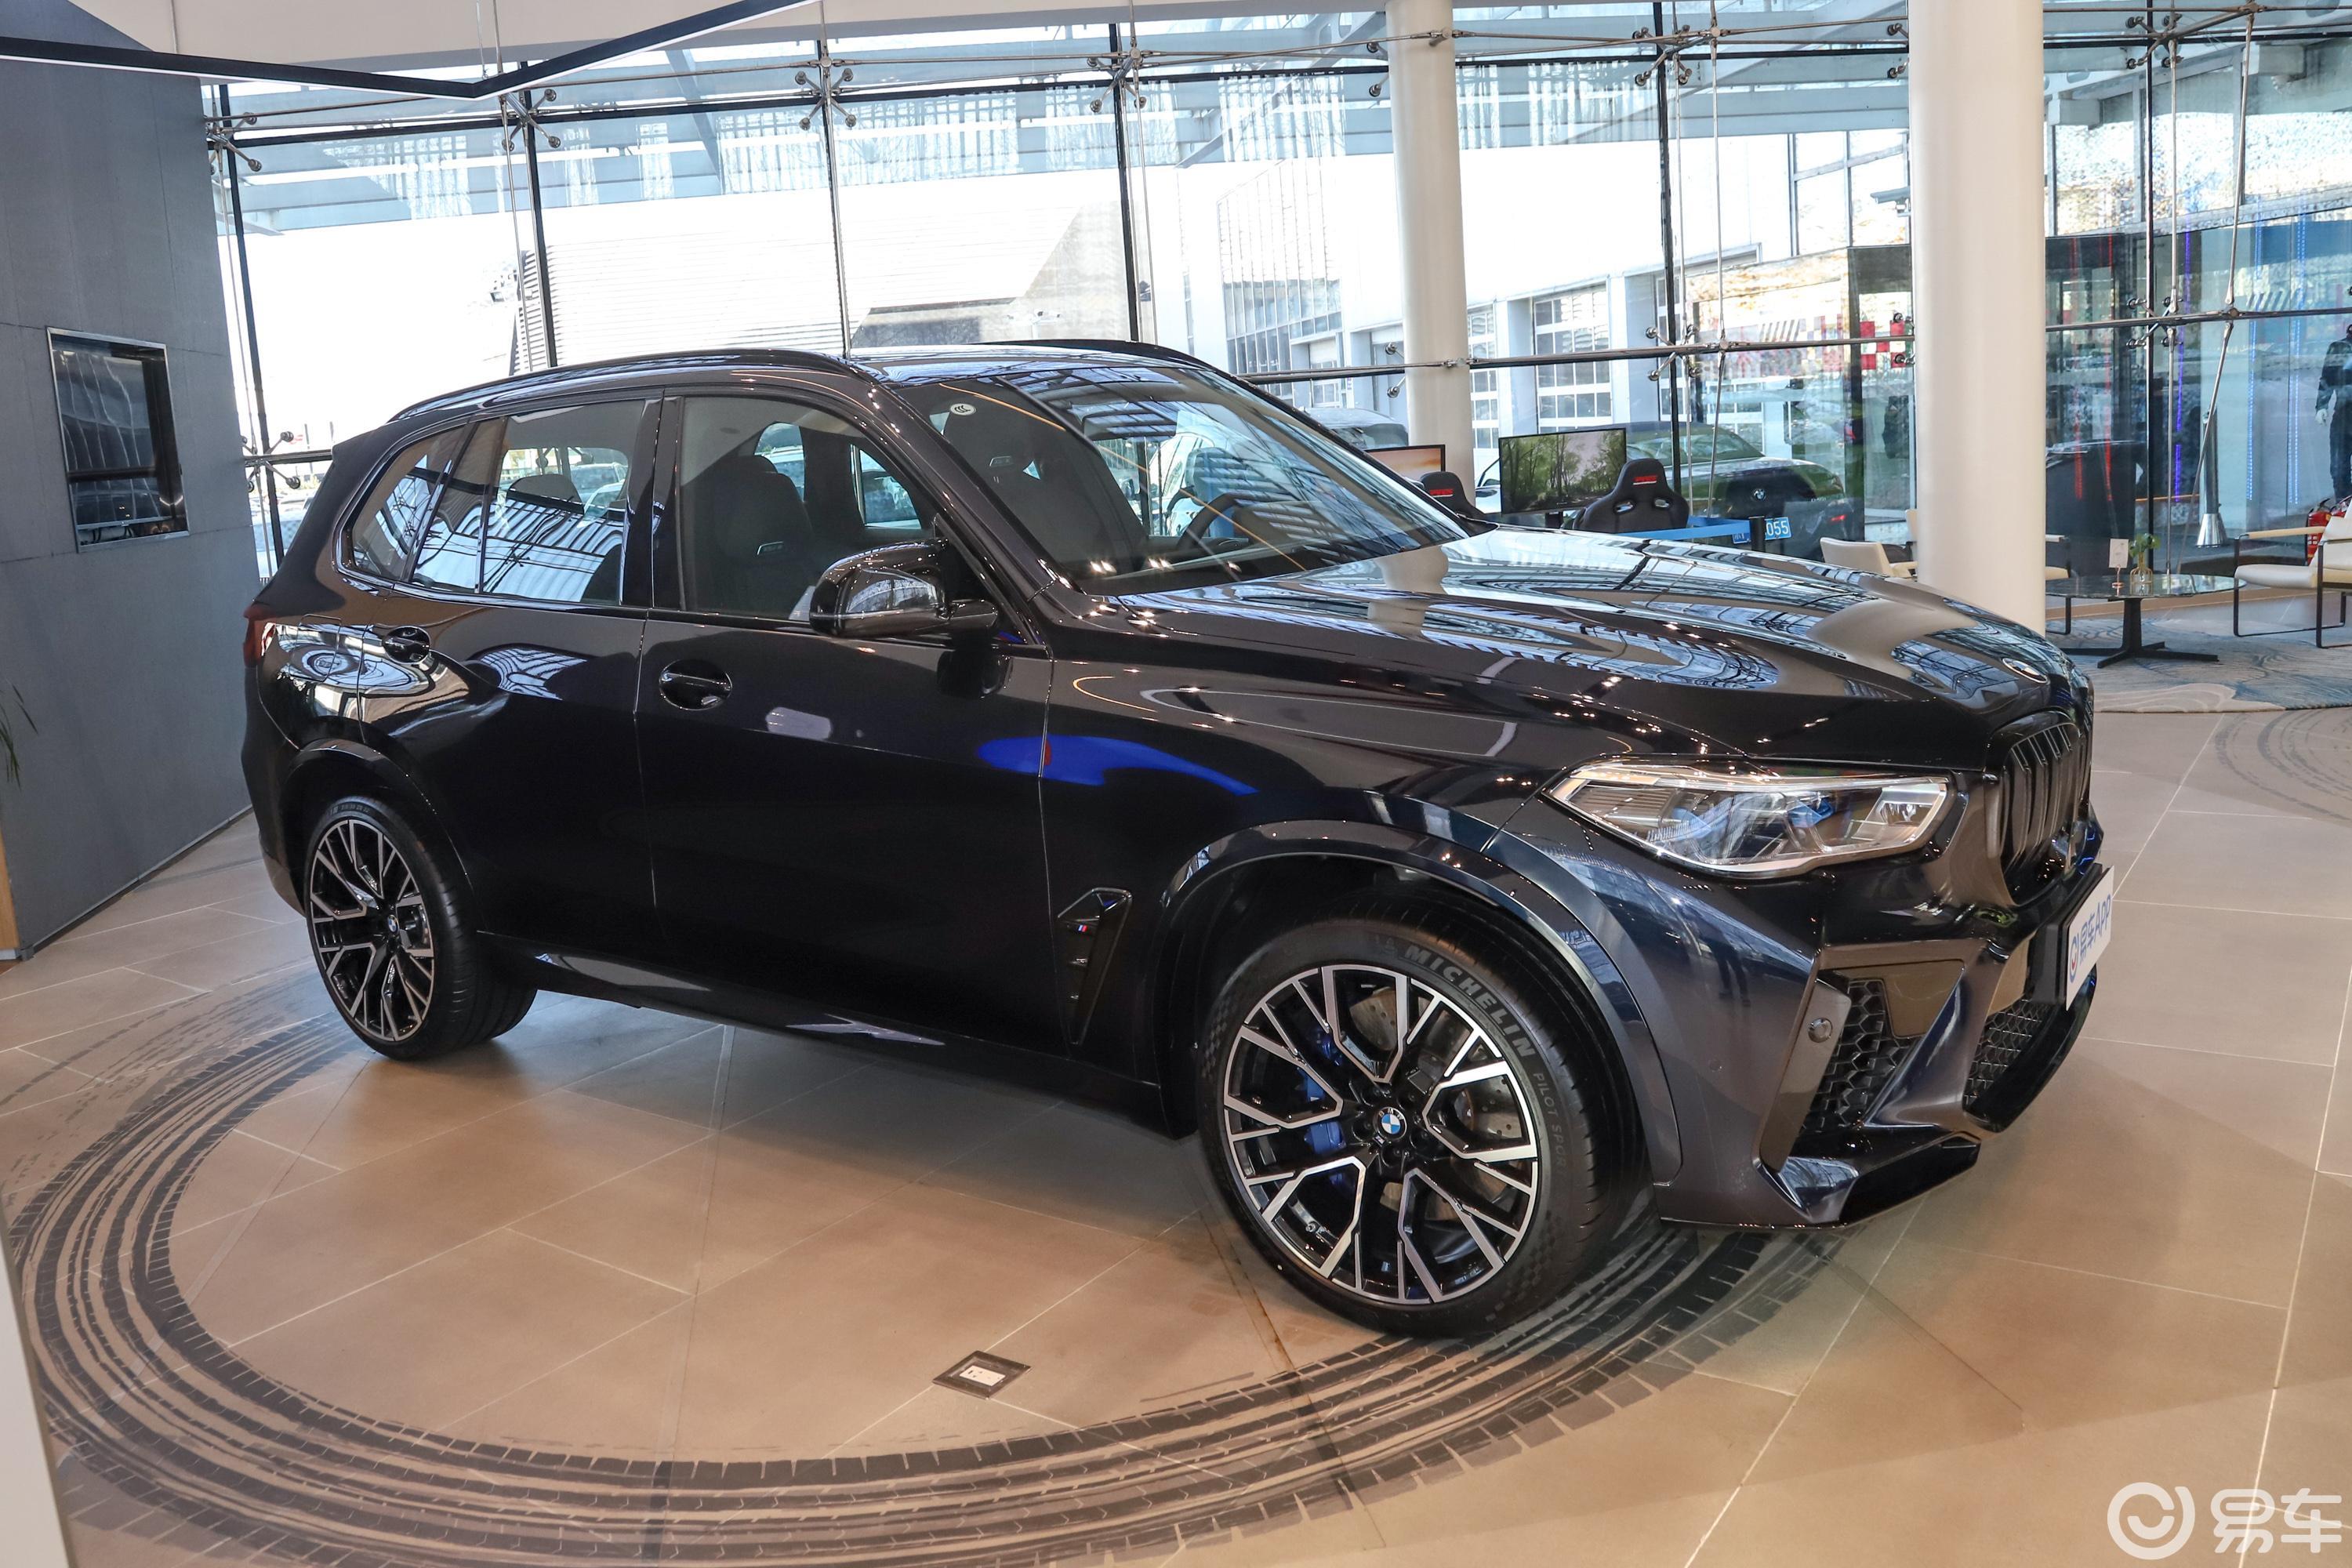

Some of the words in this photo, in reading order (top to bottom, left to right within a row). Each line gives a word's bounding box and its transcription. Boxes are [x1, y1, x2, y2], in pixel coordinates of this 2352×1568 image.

[1765, 521, 1789, 536] 055
[1405, 946, 1536, 1057] MICHELIN
[1533, 1073, 1559, 1118] PILOT
[1378, 1107, 1404, 1120] BMW
